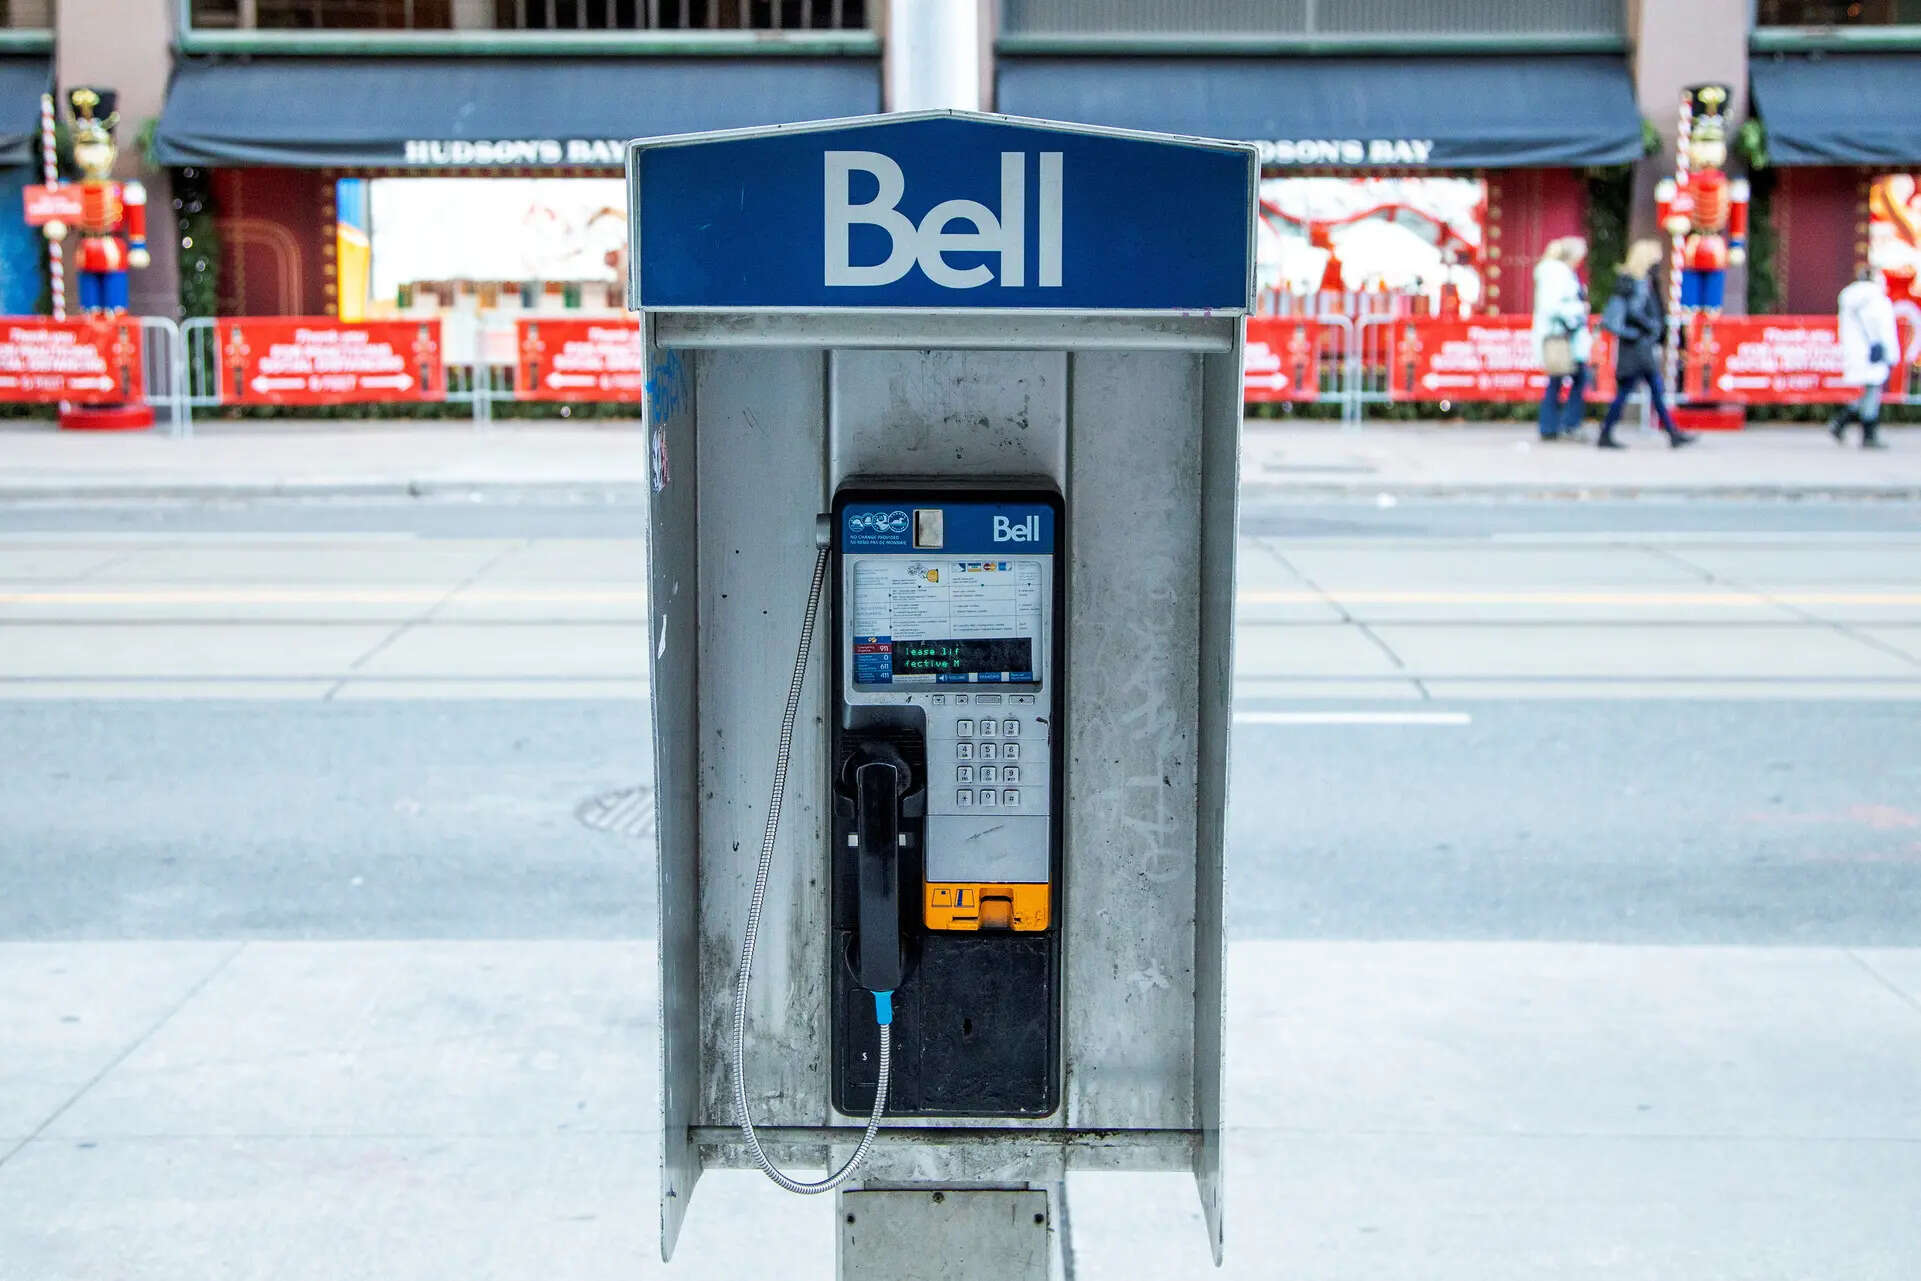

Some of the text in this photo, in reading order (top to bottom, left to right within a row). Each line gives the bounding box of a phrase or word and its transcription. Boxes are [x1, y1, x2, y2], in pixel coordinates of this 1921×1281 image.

[405, 139, 625, 164] HUDSON'S BAY
[1253, 139, 1434, 164] DSON'S BAY
[824, 150, 1063, 288] Bell
[993, 515, 1040, 542] Bell
